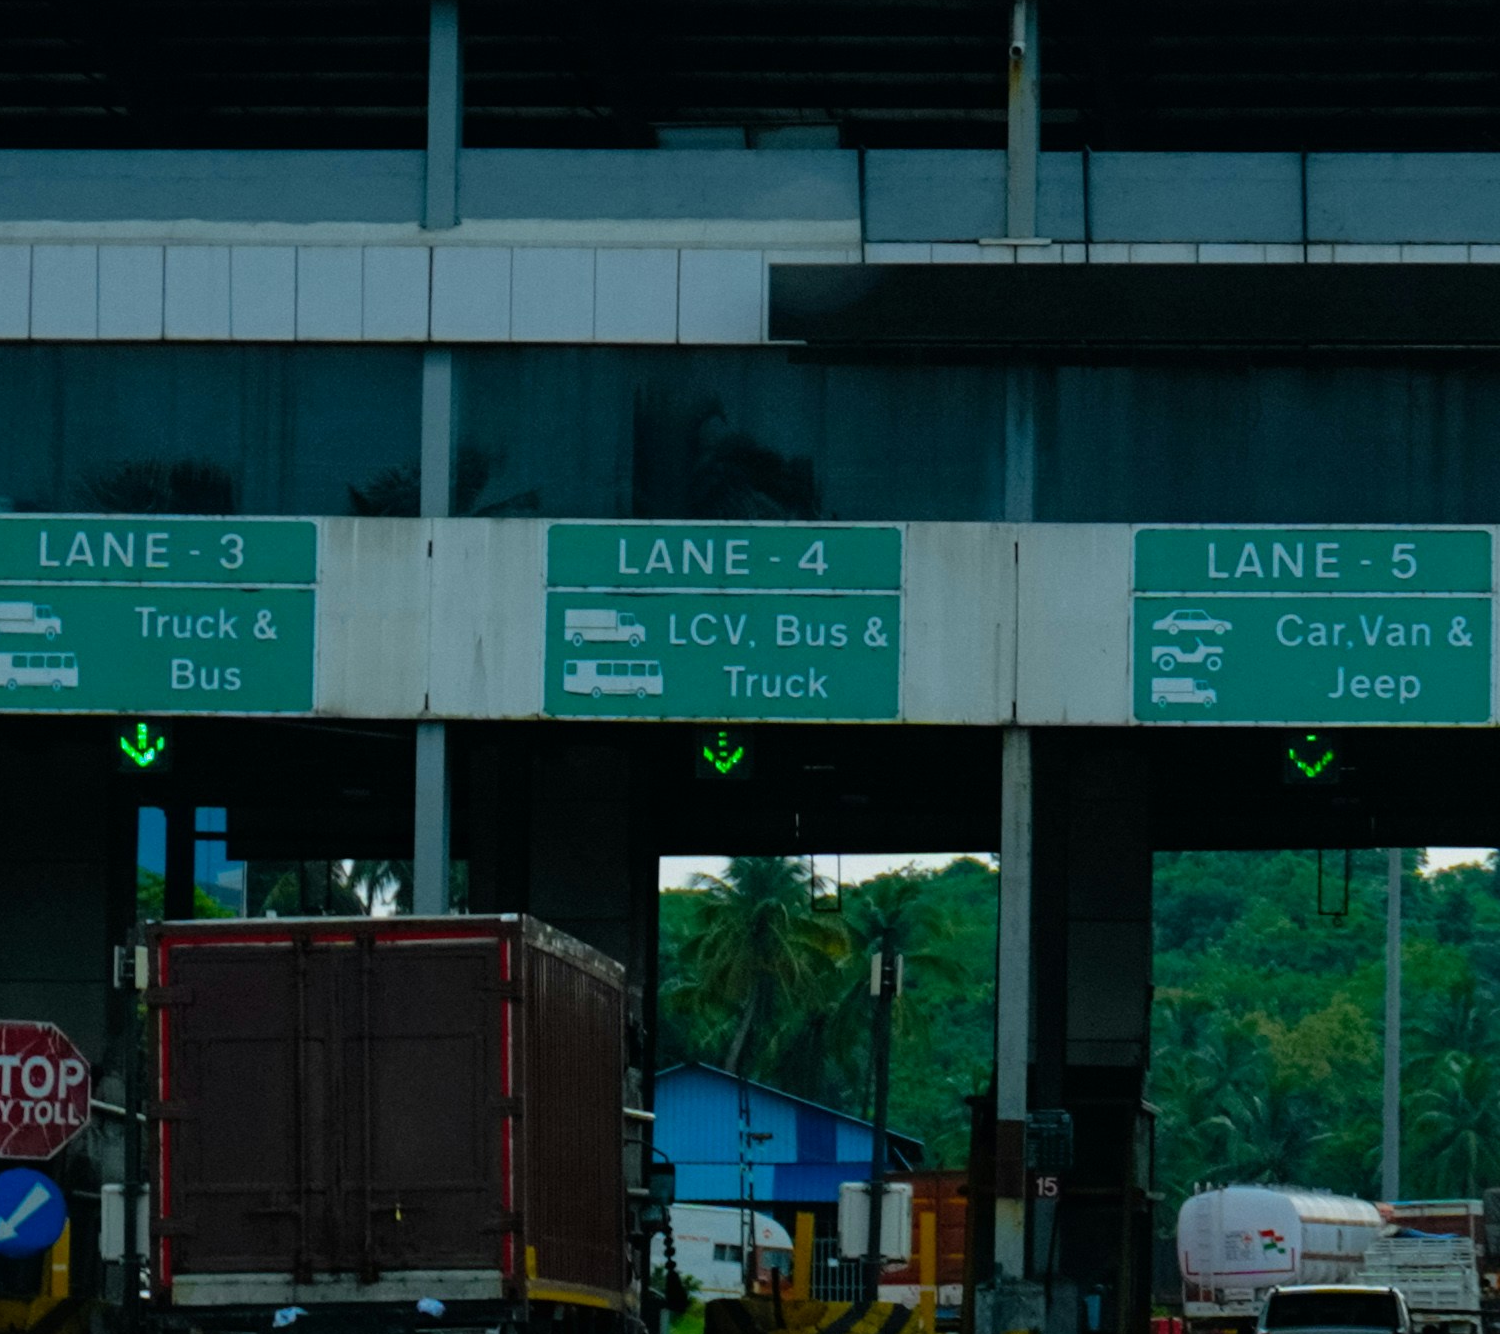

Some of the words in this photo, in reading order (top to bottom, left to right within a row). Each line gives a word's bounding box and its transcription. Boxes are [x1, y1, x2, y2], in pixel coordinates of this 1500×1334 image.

[39, 531, 170, 568] LANE
[219, 534, 244, 569] 3
[618, 538, 750, 575] LANE
[798, 540, 828, 575] 4
[1207, 542, 1340, 578] LANE
[1391, 543, 1417, 579] 5
[134, 606, 238, 639] Truck
[253, 609, 278, 640] &
[669, 613, 755, 649] LCV,
[776, 615, 848, 648] Bus
[863, 617, 888, 648] &
[1447, 616, 1473, 648] &
[170, 658, 241, 691] Bus
[723, 666, 828, 699] Truck
[1328, 666, 1421, 704] Jeep
[20, 1101, 80, 1125] TOLL
[1036, 1176, 1058, 1197] 15
